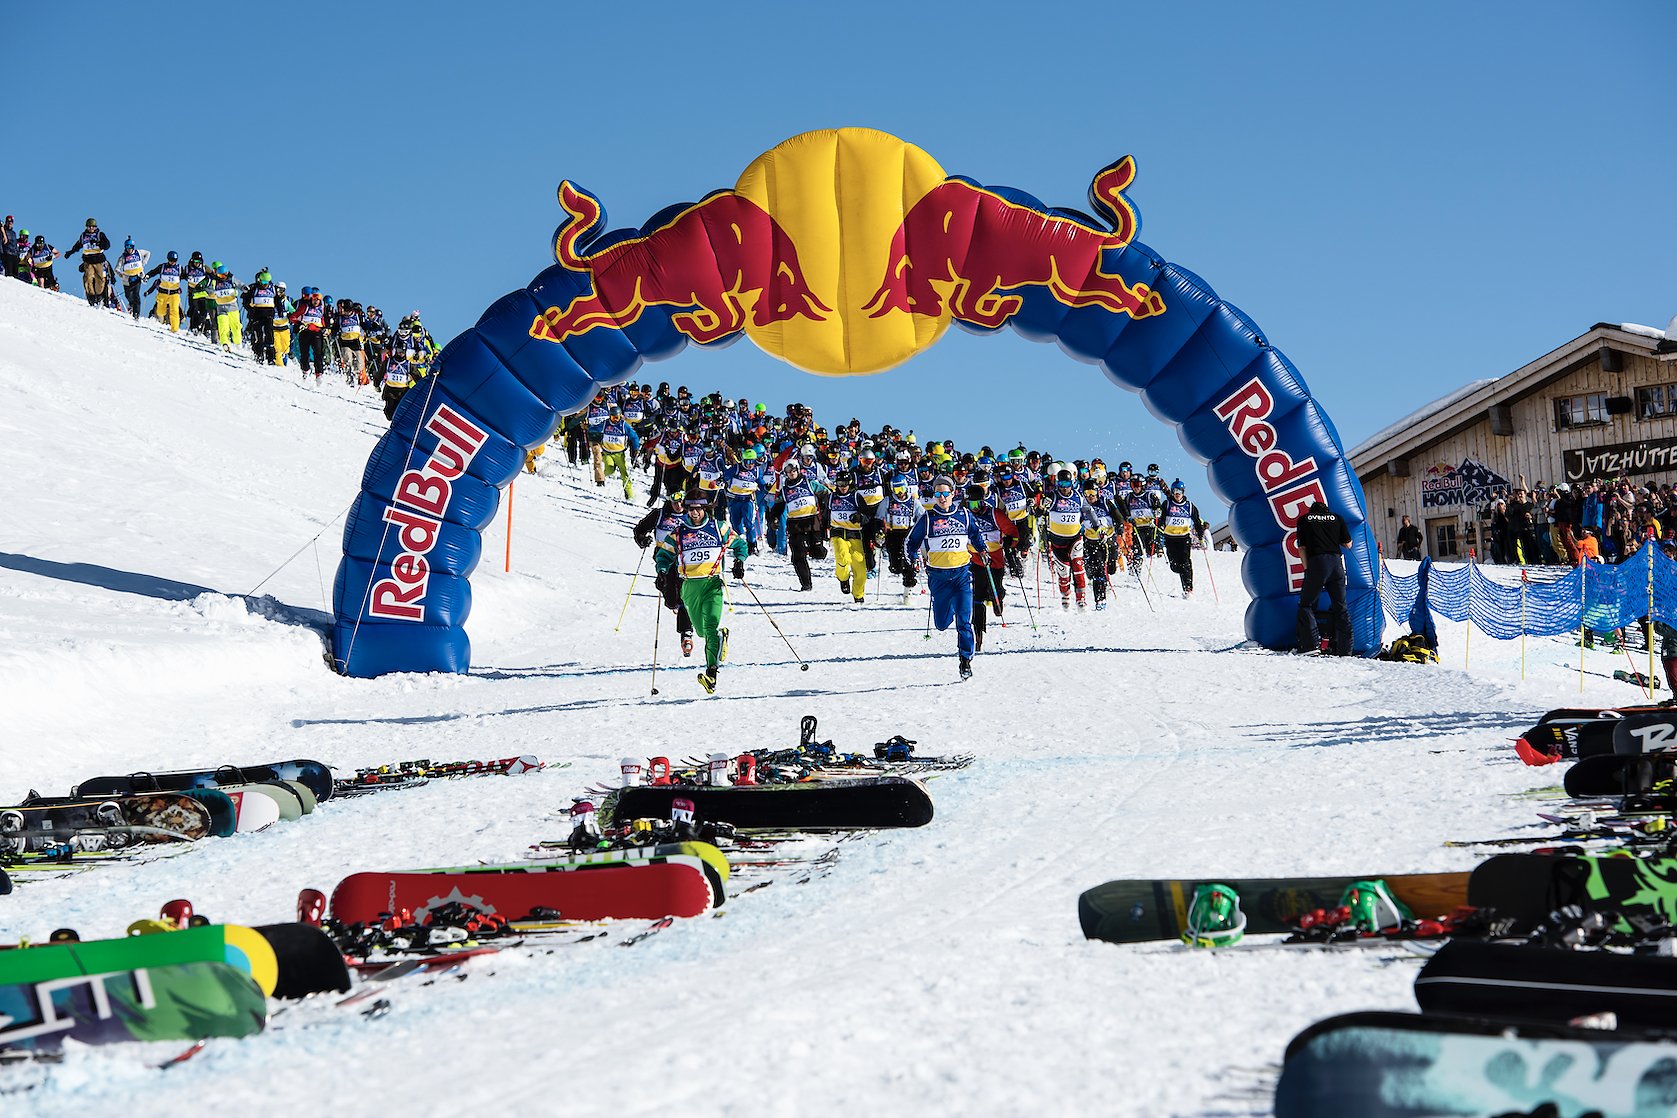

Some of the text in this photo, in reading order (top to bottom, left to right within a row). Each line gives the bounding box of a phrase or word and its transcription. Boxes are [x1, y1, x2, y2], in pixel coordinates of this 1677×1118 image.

[1212, 376, 1319, 494] Red
[1422, 475, 1463, 491] Red Bull
[369, 403, 489, 622] Red Bull
[837, 512, 848, 520] 38
[1060, 514, 1076, 523] 378
[941, 538, 961, 549] 229
[690, 550, 711, 562] 295
